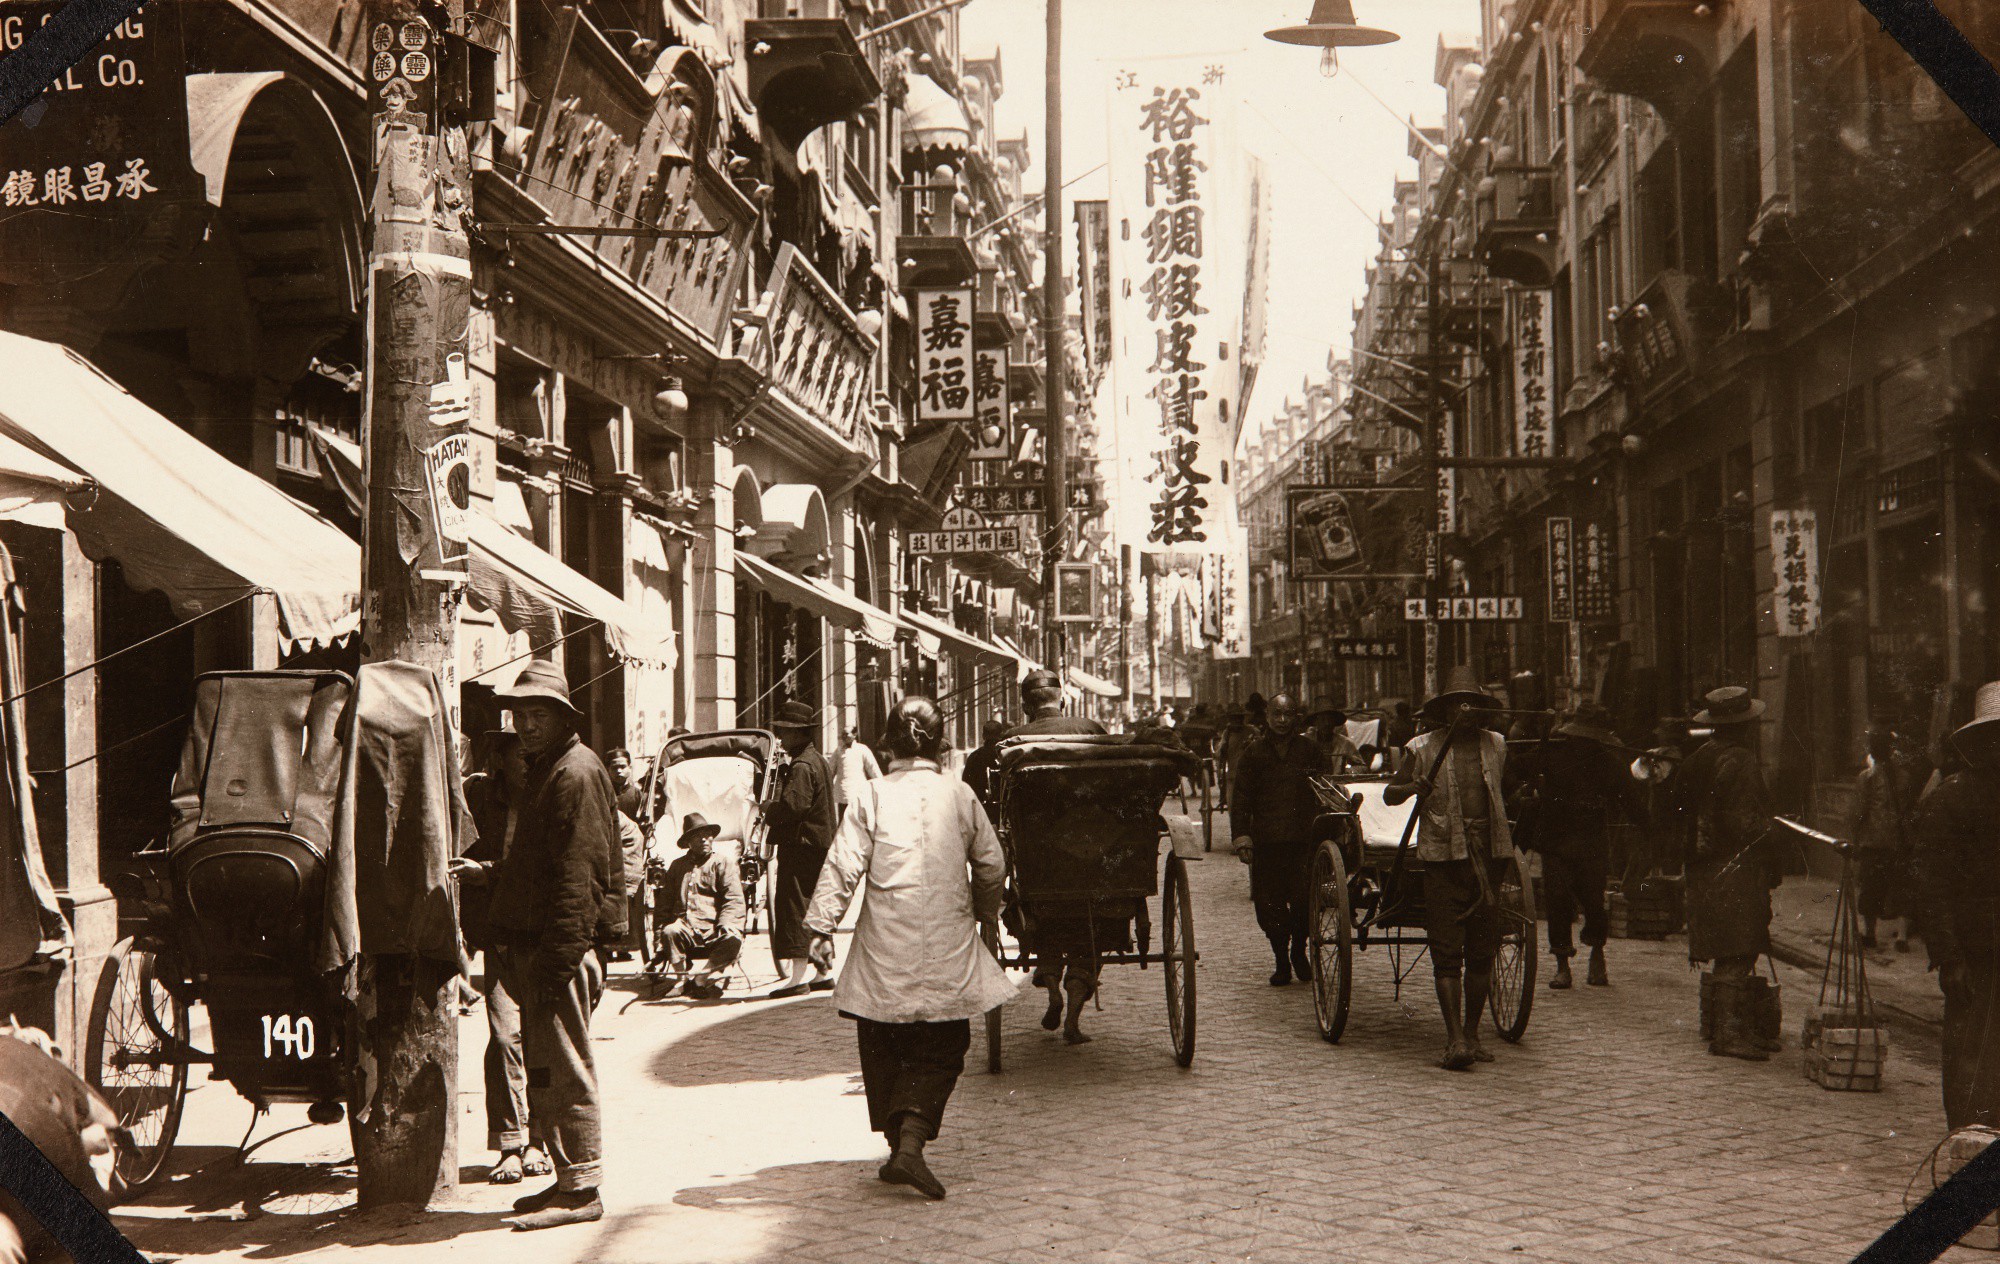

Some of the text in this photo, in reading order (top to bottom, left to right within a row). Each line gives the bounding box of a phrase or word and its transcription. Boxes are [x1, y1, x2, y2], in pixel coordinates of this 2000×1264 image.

[98, 54, 144, 87] Co.
[922, 294, 971, 412] 嘉福
[261, 1014, 315, 1060] 140
